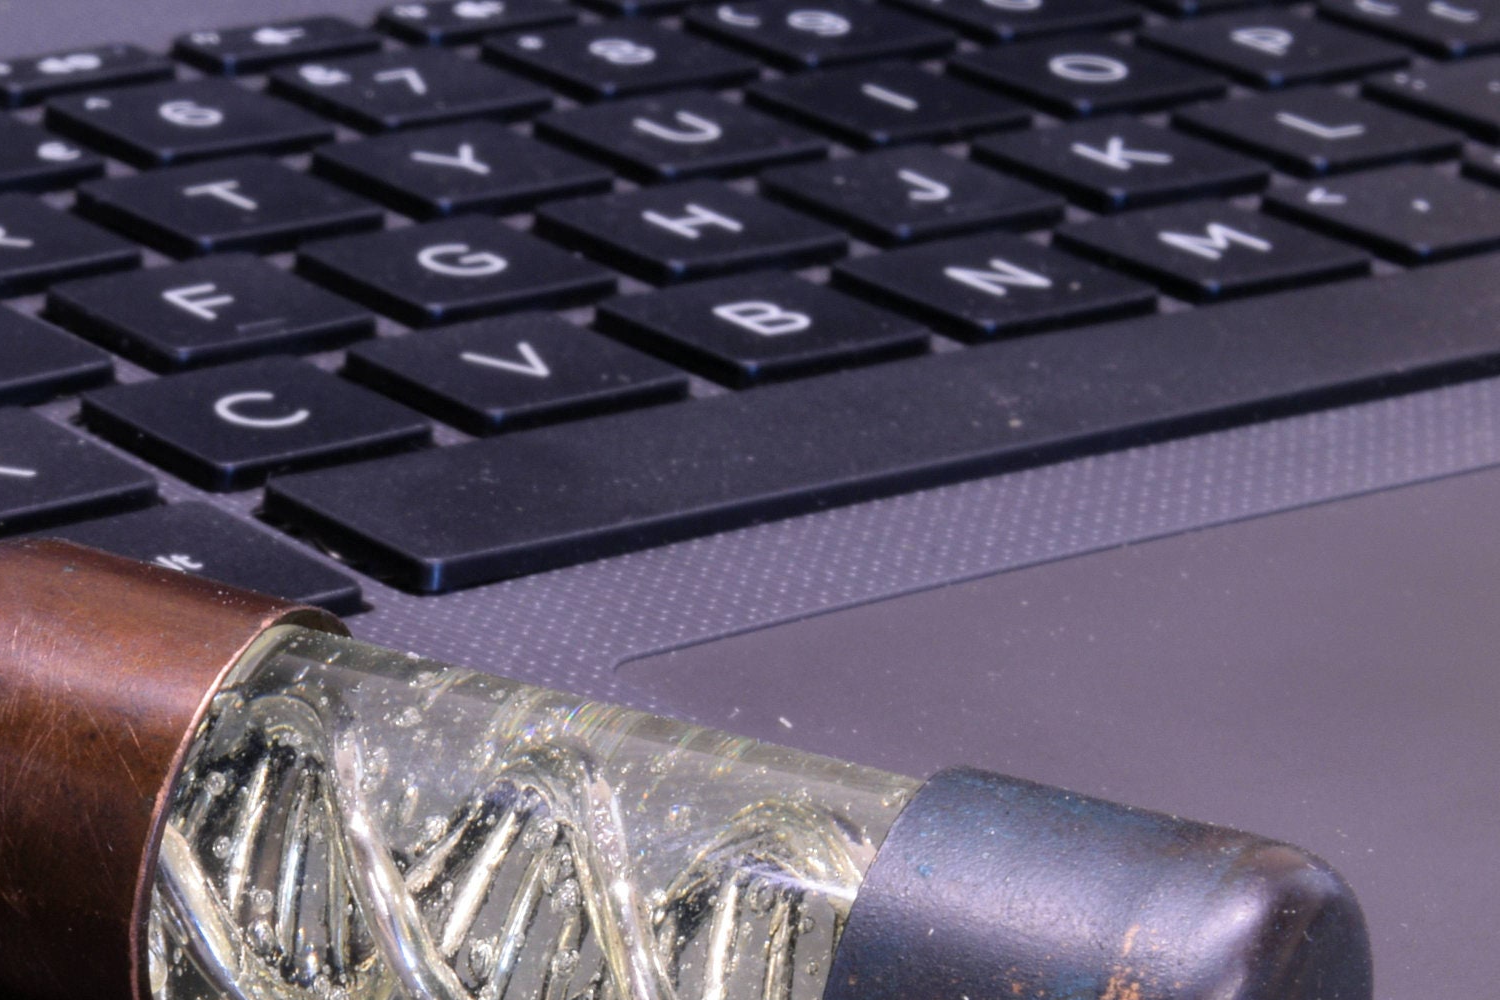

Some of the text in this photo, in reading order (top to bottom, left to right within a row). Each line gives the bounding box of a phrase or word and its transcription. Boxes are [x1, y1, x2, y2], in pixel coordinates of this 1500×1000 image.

[787, 10, 851, 36] 9
[589, 39, 655, 65] 8
[1231, 27, 1293, 55] P
[375, 68, 427, 95] 7
[1049, 54, 1128, 82] O
[159, 100, 223, 127] 6
[633, 111, 722, 143] U
[1277, 112, 1364, 140] L
[412, 144, 490, 174] Y
[1072, 137, 1170, 170] K
[184, 180, 257, 210] T
[899, 169, 950, 201] J
[642, 203, 743, 239] H
[1159, 222, 1270, 260] M
[417, 243, 508, 277] G
[944, 259, 1052, 296] N
[162, 283, 234, 320] F
[713, 301, 811, 336] B
[461, 341, 550, 378] V
[214, 391, 310, 428] C
[155, 554, 204, 572] lt
